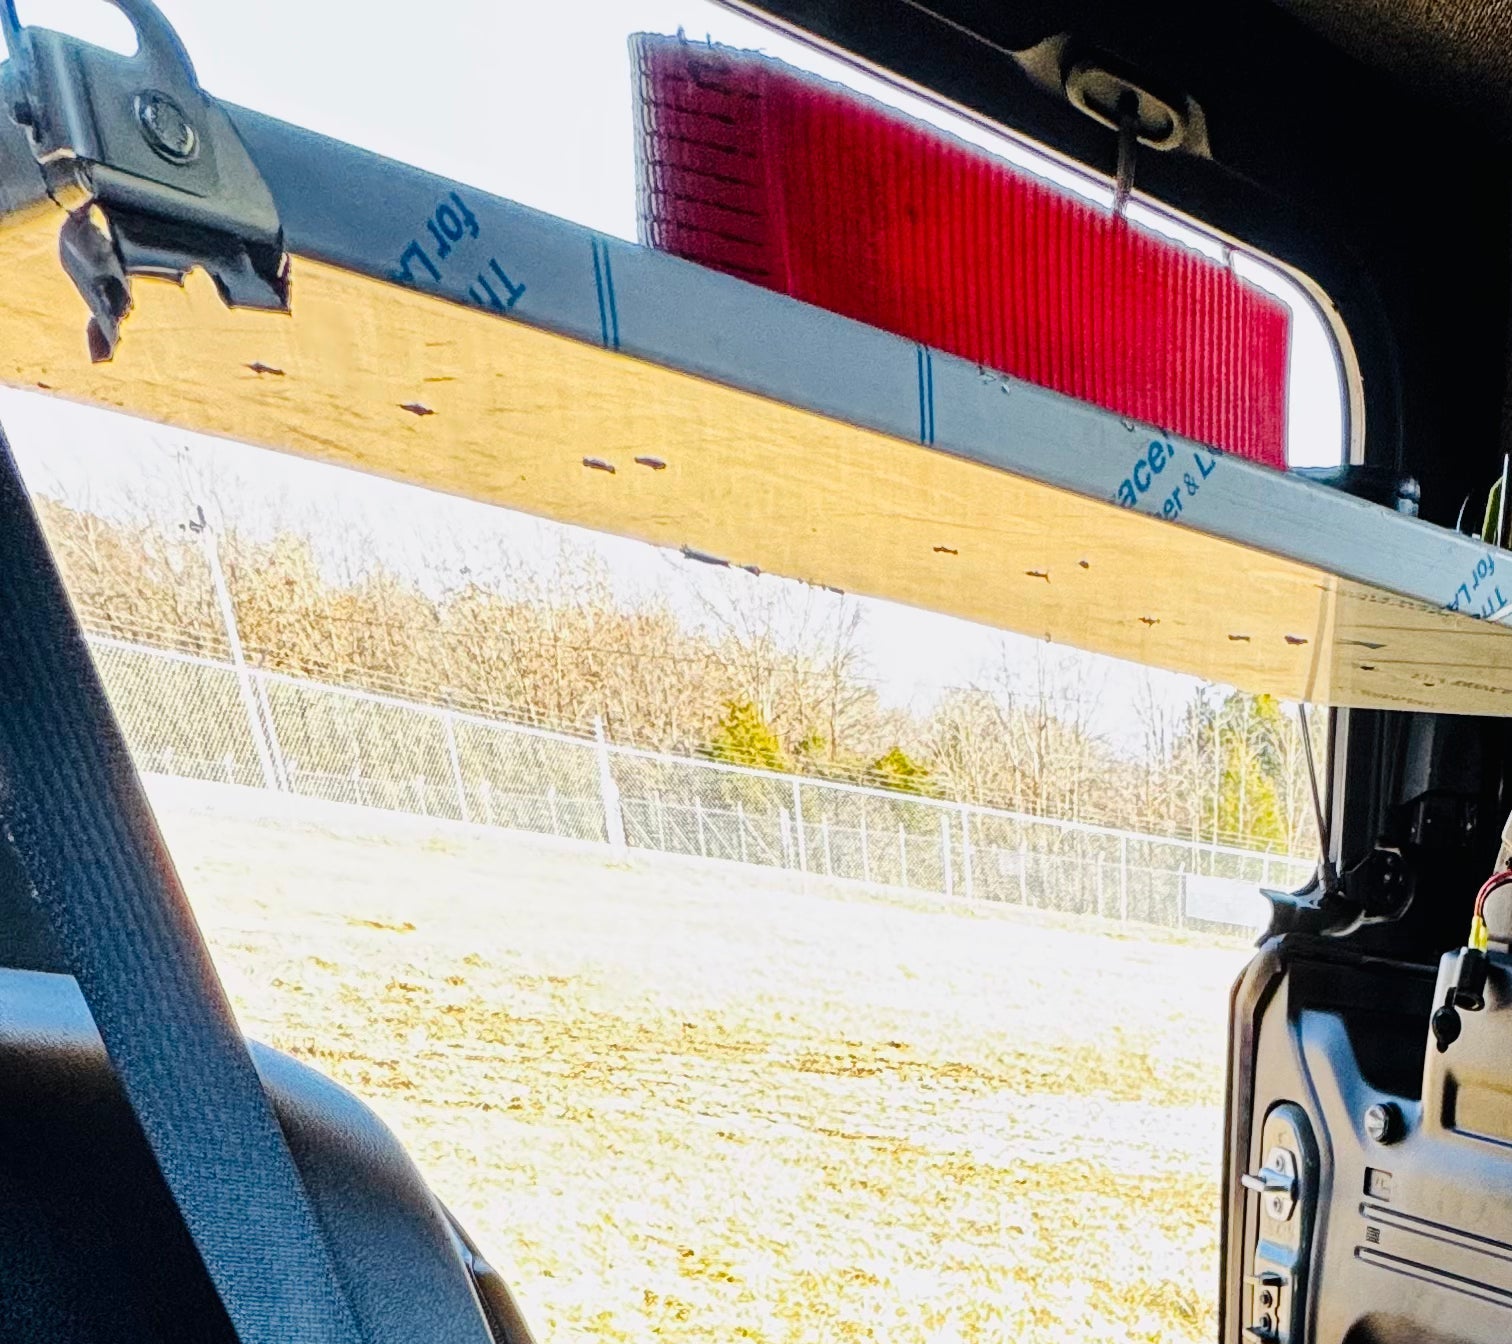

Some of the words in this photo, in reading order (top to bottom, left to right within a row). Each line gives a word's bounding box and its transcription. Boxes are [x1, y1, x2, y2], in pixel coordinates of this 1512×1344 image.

[427, 191, 480, 260] for
[1184, 472, 1199, 496] &
[1473, 552, 1495, 591] for
